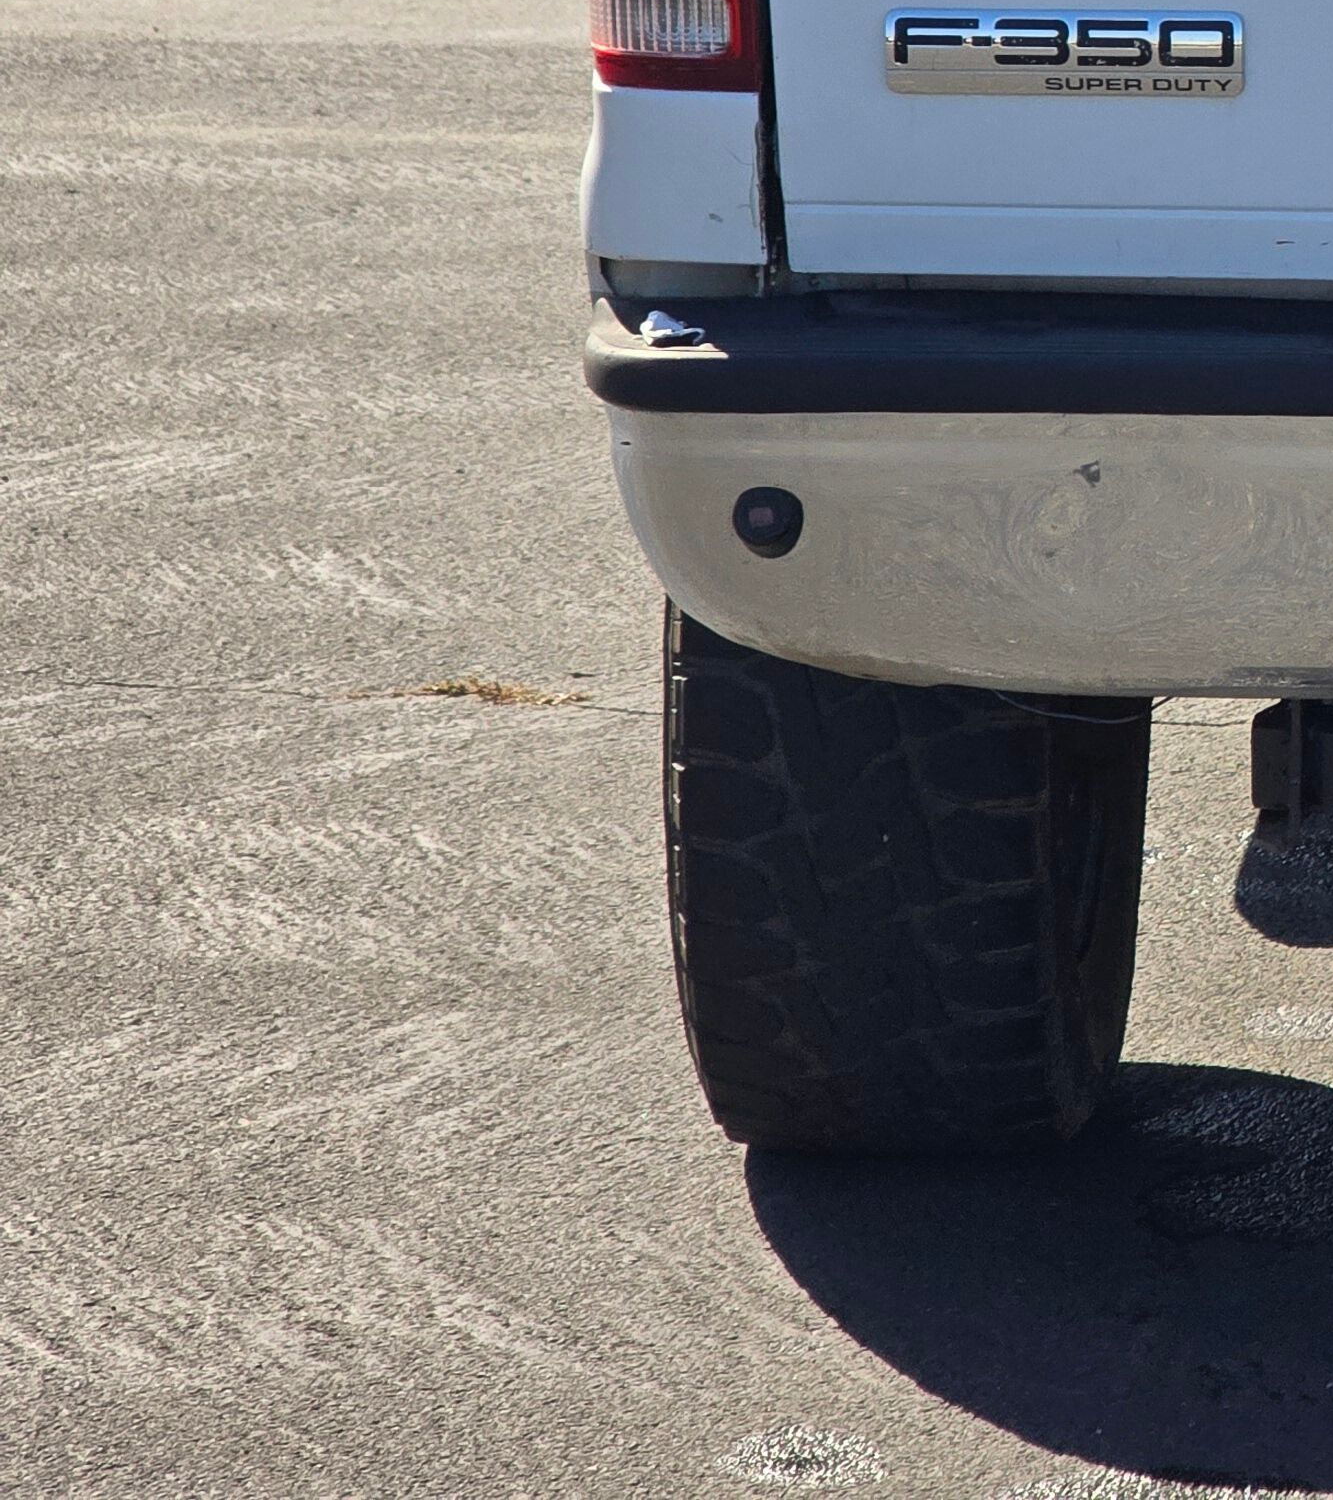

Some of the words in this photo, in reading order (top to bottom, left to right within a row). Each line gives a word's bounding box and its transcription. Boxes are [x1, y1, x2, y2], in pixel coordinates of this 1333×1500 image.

[894, 18, 1234, 68] F-350
[1045, 77, 1142, 91] SUPER
[1153, 78, 1233, 92] DUTY
